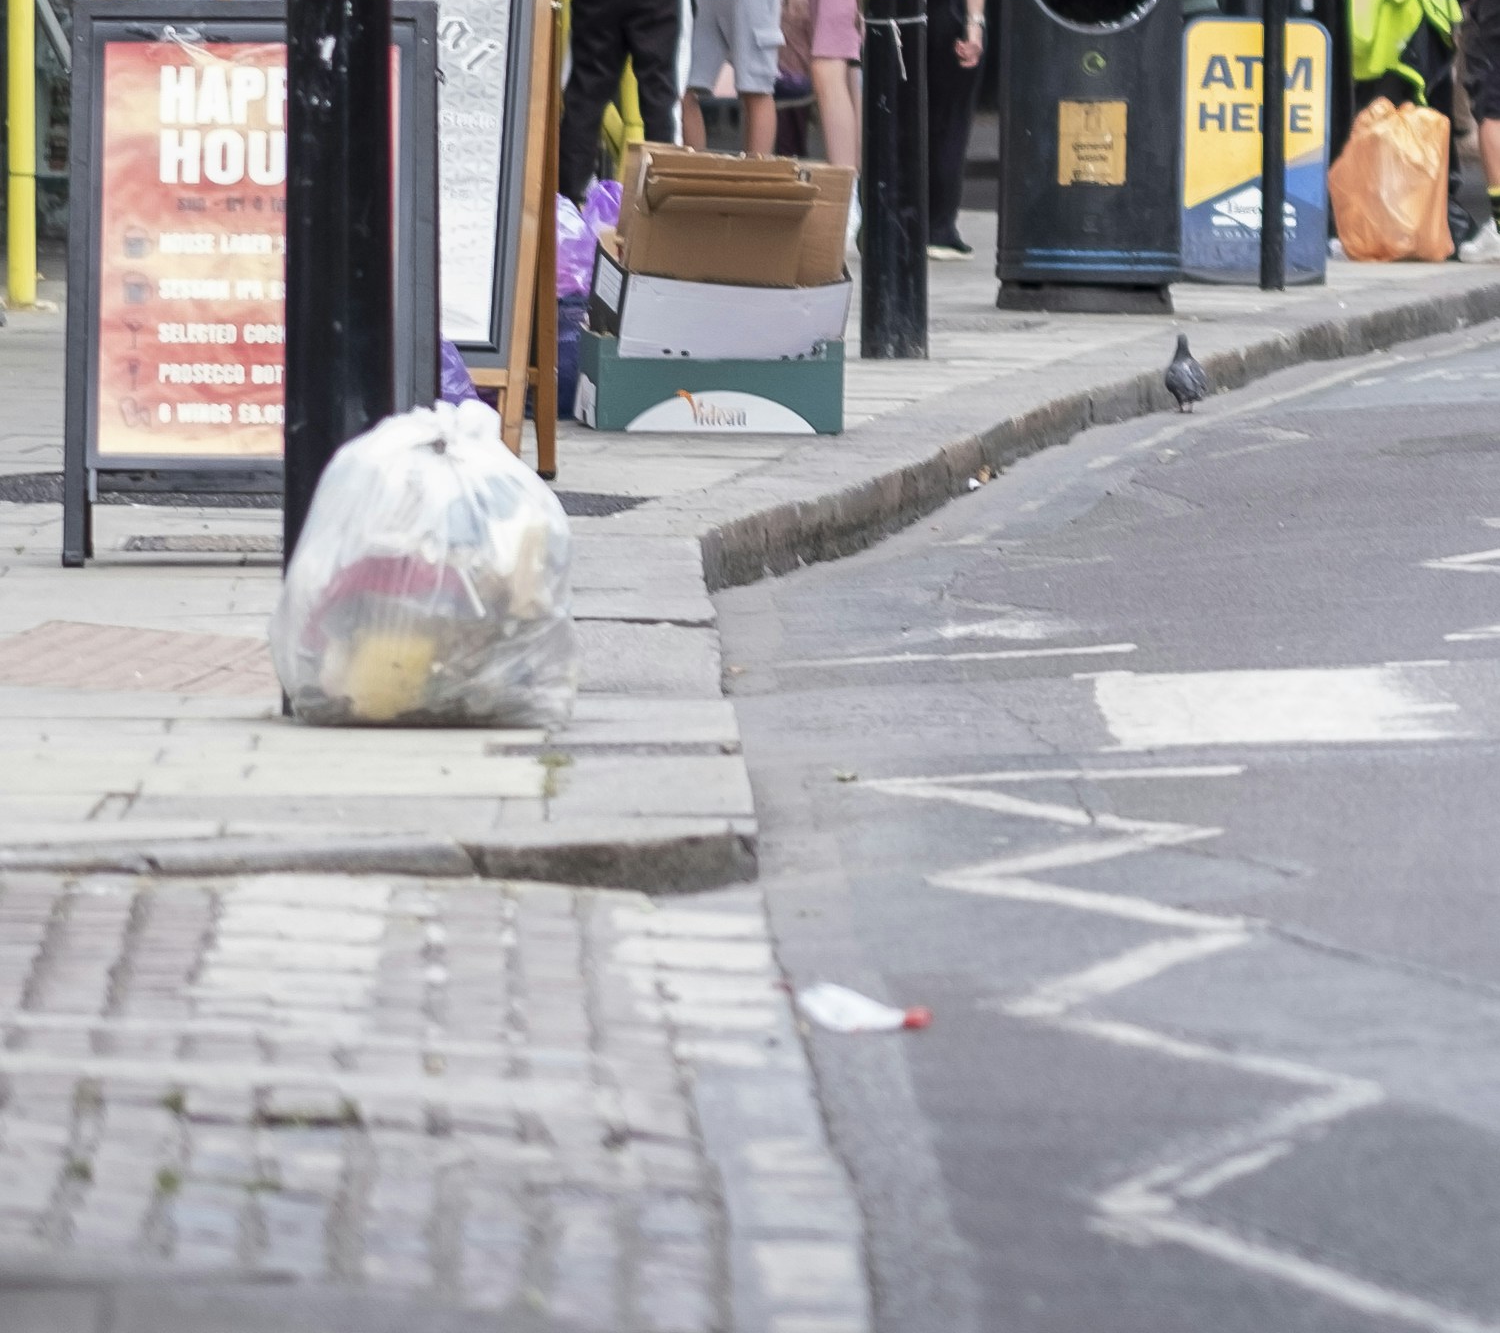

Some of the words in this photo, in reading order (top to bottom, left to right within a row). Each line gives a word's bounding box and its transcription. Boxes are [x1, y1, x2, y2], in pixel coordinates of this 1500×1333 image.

[1200, 53, 1313, 91] ATM
[159, 65, 288, 125] HAPP
[1199, 101, 1312, 133] HEE
[158, 129, 288, 186] HOU
[158, 323, 236, 344] SELECTED
[243, 324, 285, 344] COC
[158, 364, 244, 384] PROSECCO
[252, 364, 285, 384] BOT
